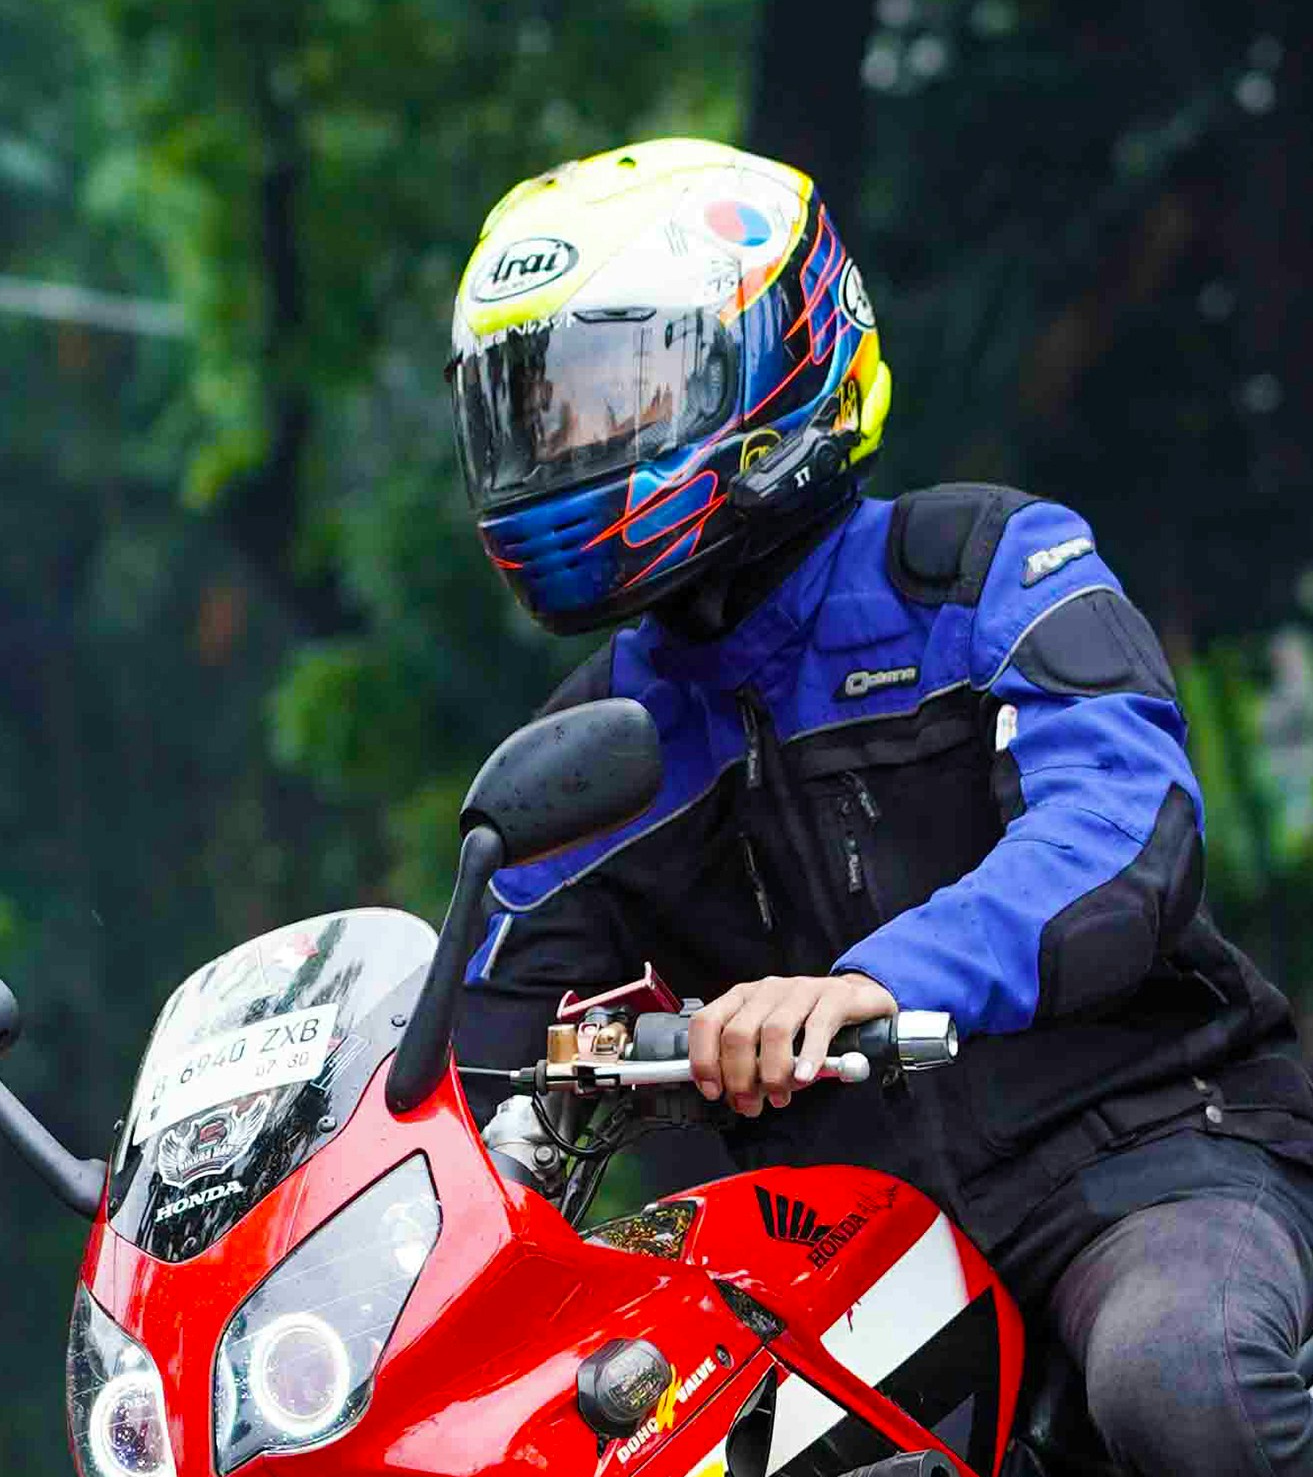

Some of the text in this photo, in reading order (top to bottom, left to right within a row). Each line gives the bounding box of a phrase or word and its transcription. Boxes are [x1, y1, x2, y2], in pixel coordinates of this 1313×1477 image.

[259, 1017, 320, 1053] ZXB
[154, 1180, 244, 1223] HONDA
[806, 1212, 870, 1272] HONDA
[616, 1416, 659, 1465] DOHC
[675, 1356, 717, 1404] VALVE
